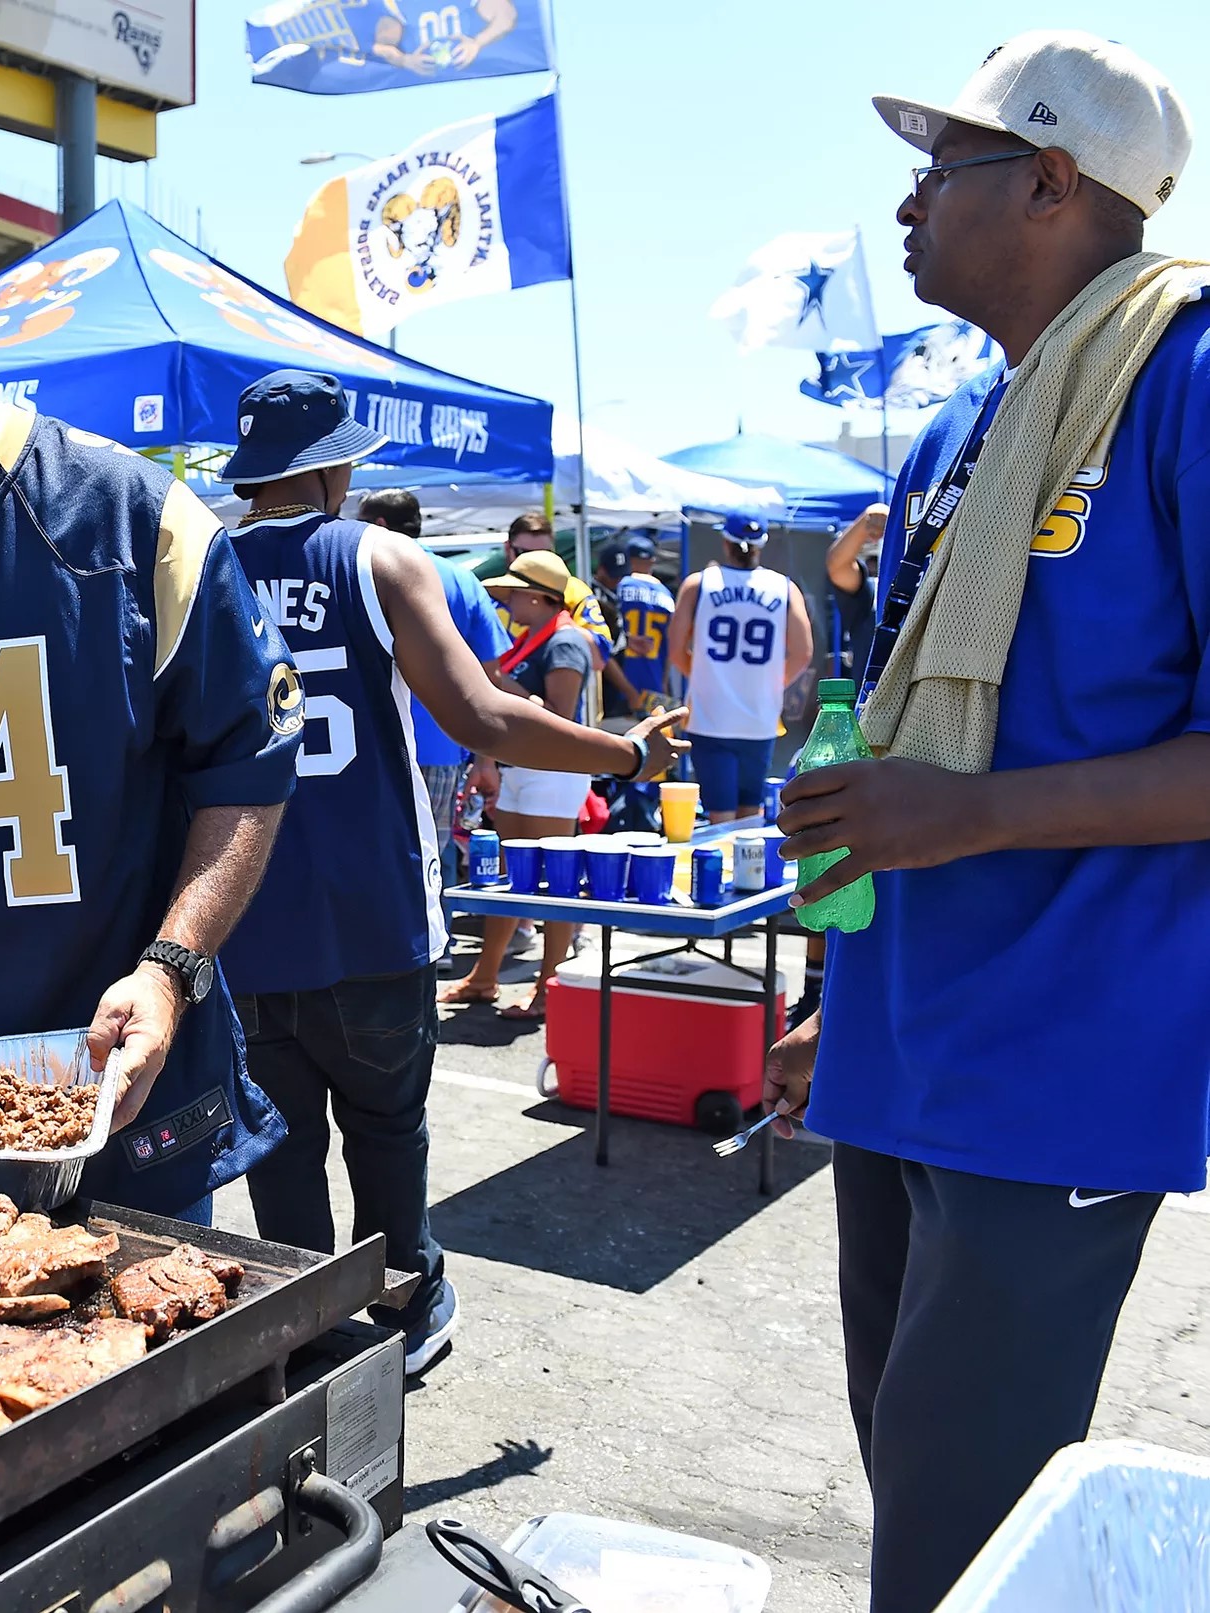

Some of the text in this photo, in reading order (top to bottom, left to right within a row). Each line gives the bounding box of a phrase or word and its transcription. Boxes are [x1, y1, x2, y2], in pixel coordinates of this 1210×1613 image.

[112, 11, 163, 48] Rams
[430, 404, 489, 464] RAMS
[927, 484, 964, 529] RAMS
[709, 587, 782, 613] DONALD
[625, 609, 668, 660] 15
[707, 615, 775, 665] 99
[175, 1105, 205, 1132] XXL
